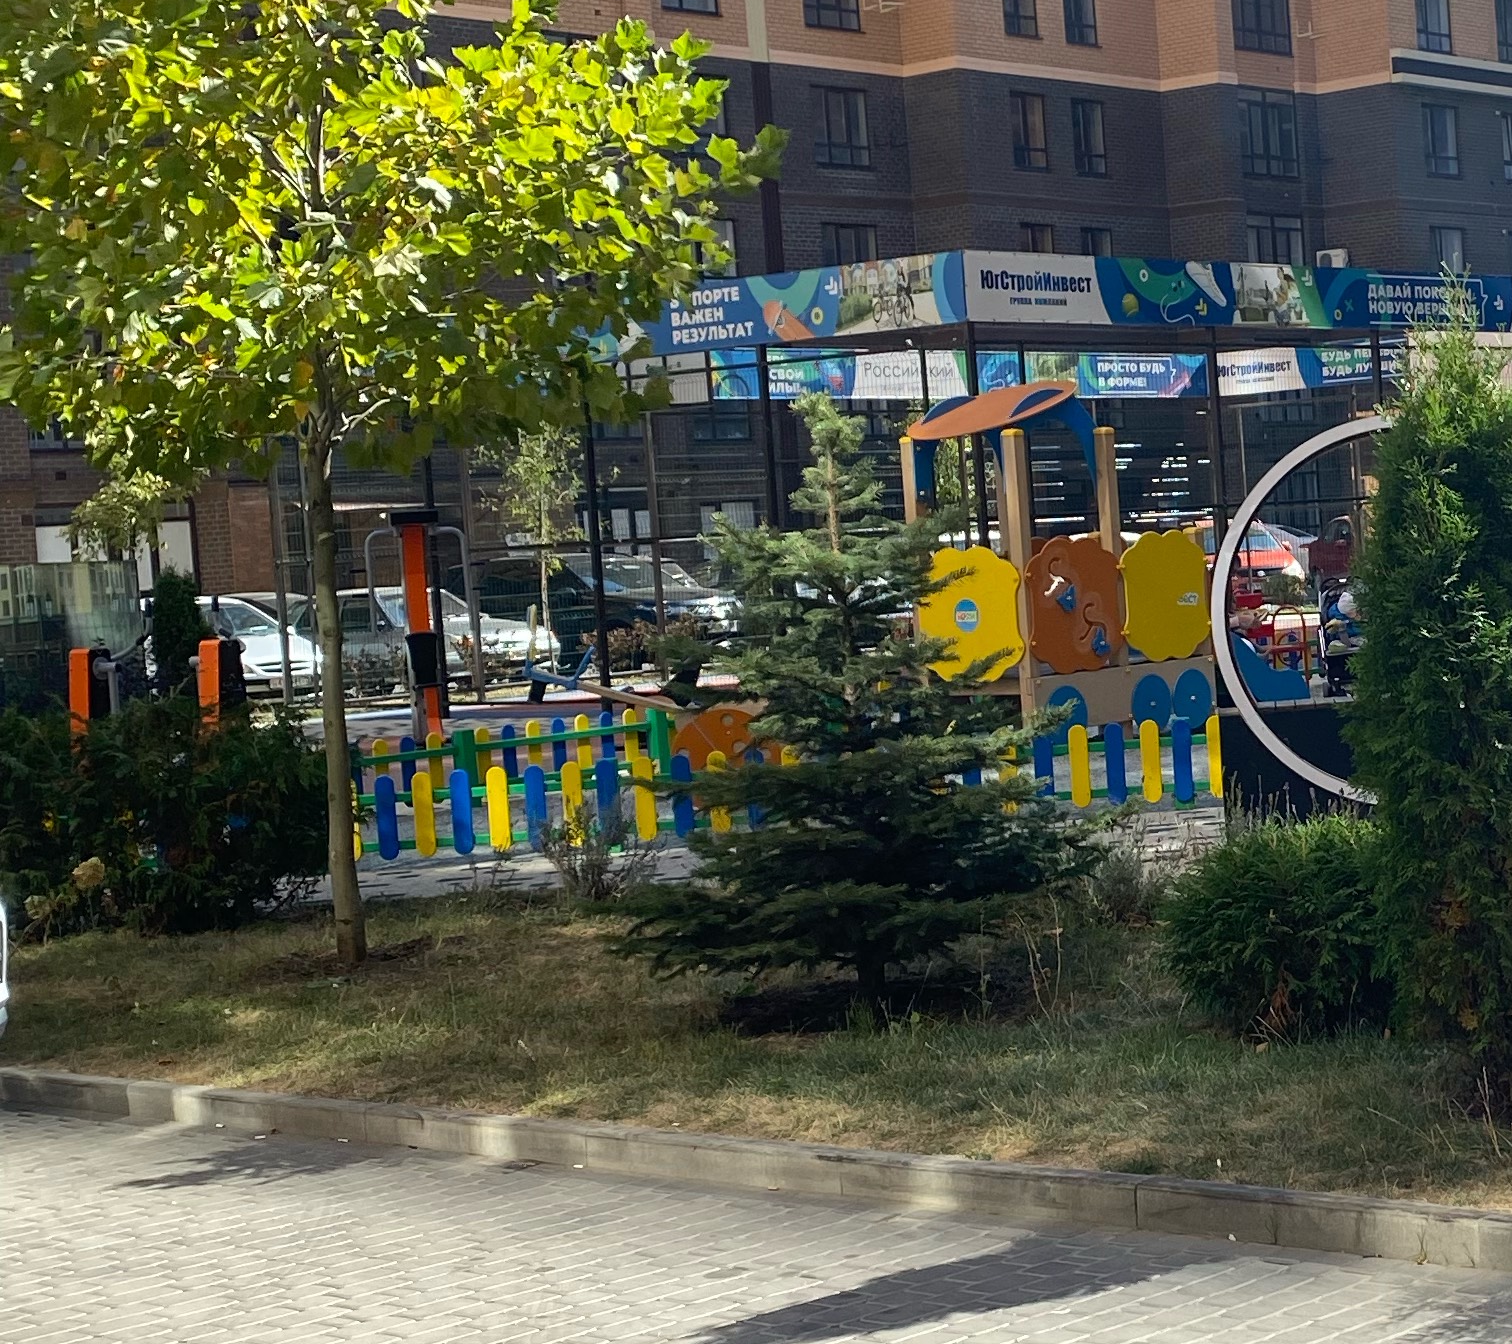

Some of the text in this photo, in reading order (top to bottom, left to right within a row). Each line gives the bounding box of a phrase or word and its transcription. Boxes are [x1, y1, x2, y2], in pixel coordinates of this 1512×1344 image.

[980, 269, 1092, 293] ЮгСтройИнвест
[688, 286, 740, 307] ПОРТЕ
[1368, 282, 1476, 303] ДАВАЙ ПОКО
[670, 306, 724, 327] ВАЖЕН
[1369, 300, 1477, 318] НОВУЮ ВЕРШ
[671, 321, 754, 346] РЕЗУЛЬТАТ
[1321, 349, 1352, 363] БУДЬ
[864, 361, 954, 378] Российкий
[1097, 362, 1166, 375] ПРОСТО БУДЬ
[1322, 365, 1353, 377] БУДЬ
[1099, 377, 1147, 388] В ФОРМЕ!
